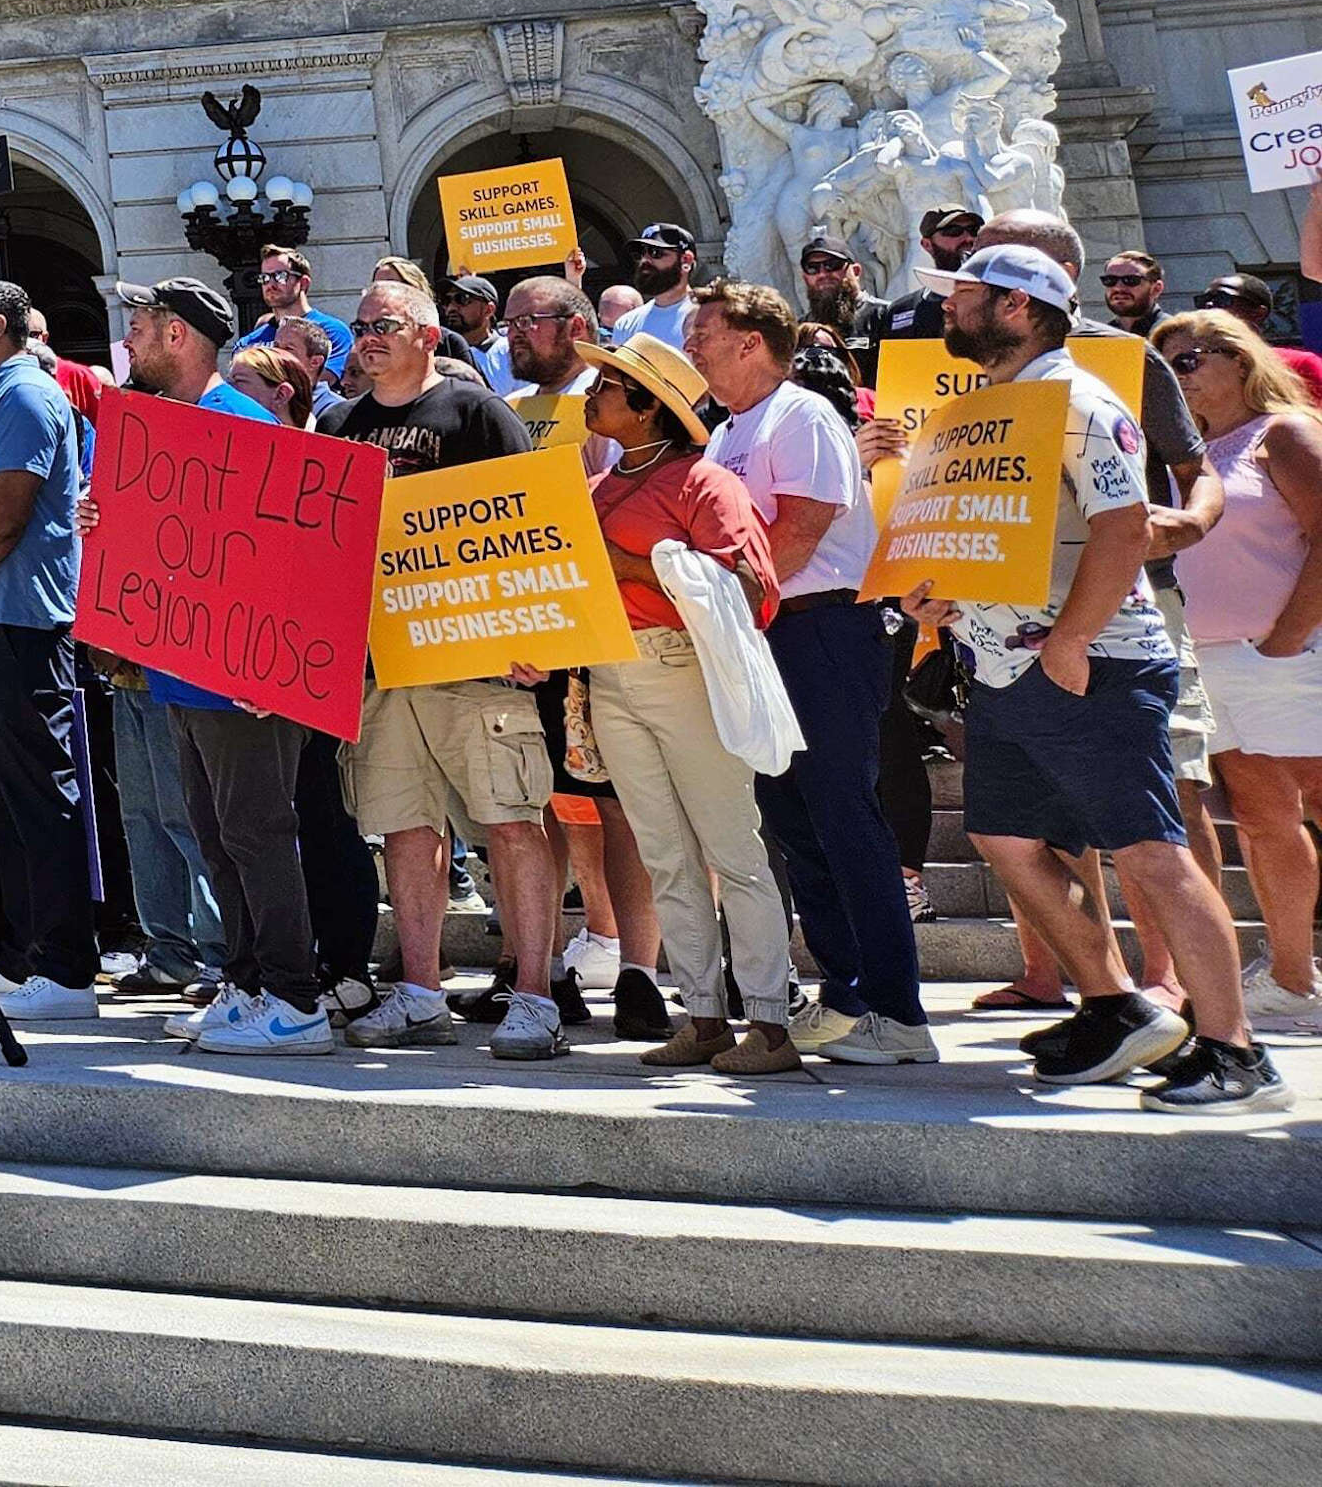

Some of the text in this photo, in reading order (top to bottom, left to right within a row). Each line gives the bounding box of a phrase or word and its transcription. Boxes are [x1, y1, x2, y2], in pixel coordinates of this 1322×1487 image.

[473, 180, 539, 202] SUPPORT
[459, 196, 559, 222] SKILL GAMES.
[460, 213, 565, 240] SUPPORT SMALL
[473, 232, 558, 255] BUSINESSES.
[930, 419, 1013, 455] SUPPORT
[116, 412, 358, 549] Don't Let
[944, 456, 1032, 483] GAMES.
[403, 492, 526, 536] SUPPORT
[891, 495, 1031, 530] SUPPORT SMALL
[381, 525, 572, 576] SKILL GAMES.
[887, 533, 1005, 562] BUSINESSES.
[96, 550, 212, 658] Legion
[382, 561, 589, 613] SUPPORT SMALL
[408, 603, 576, 647] BUSINESSES.
